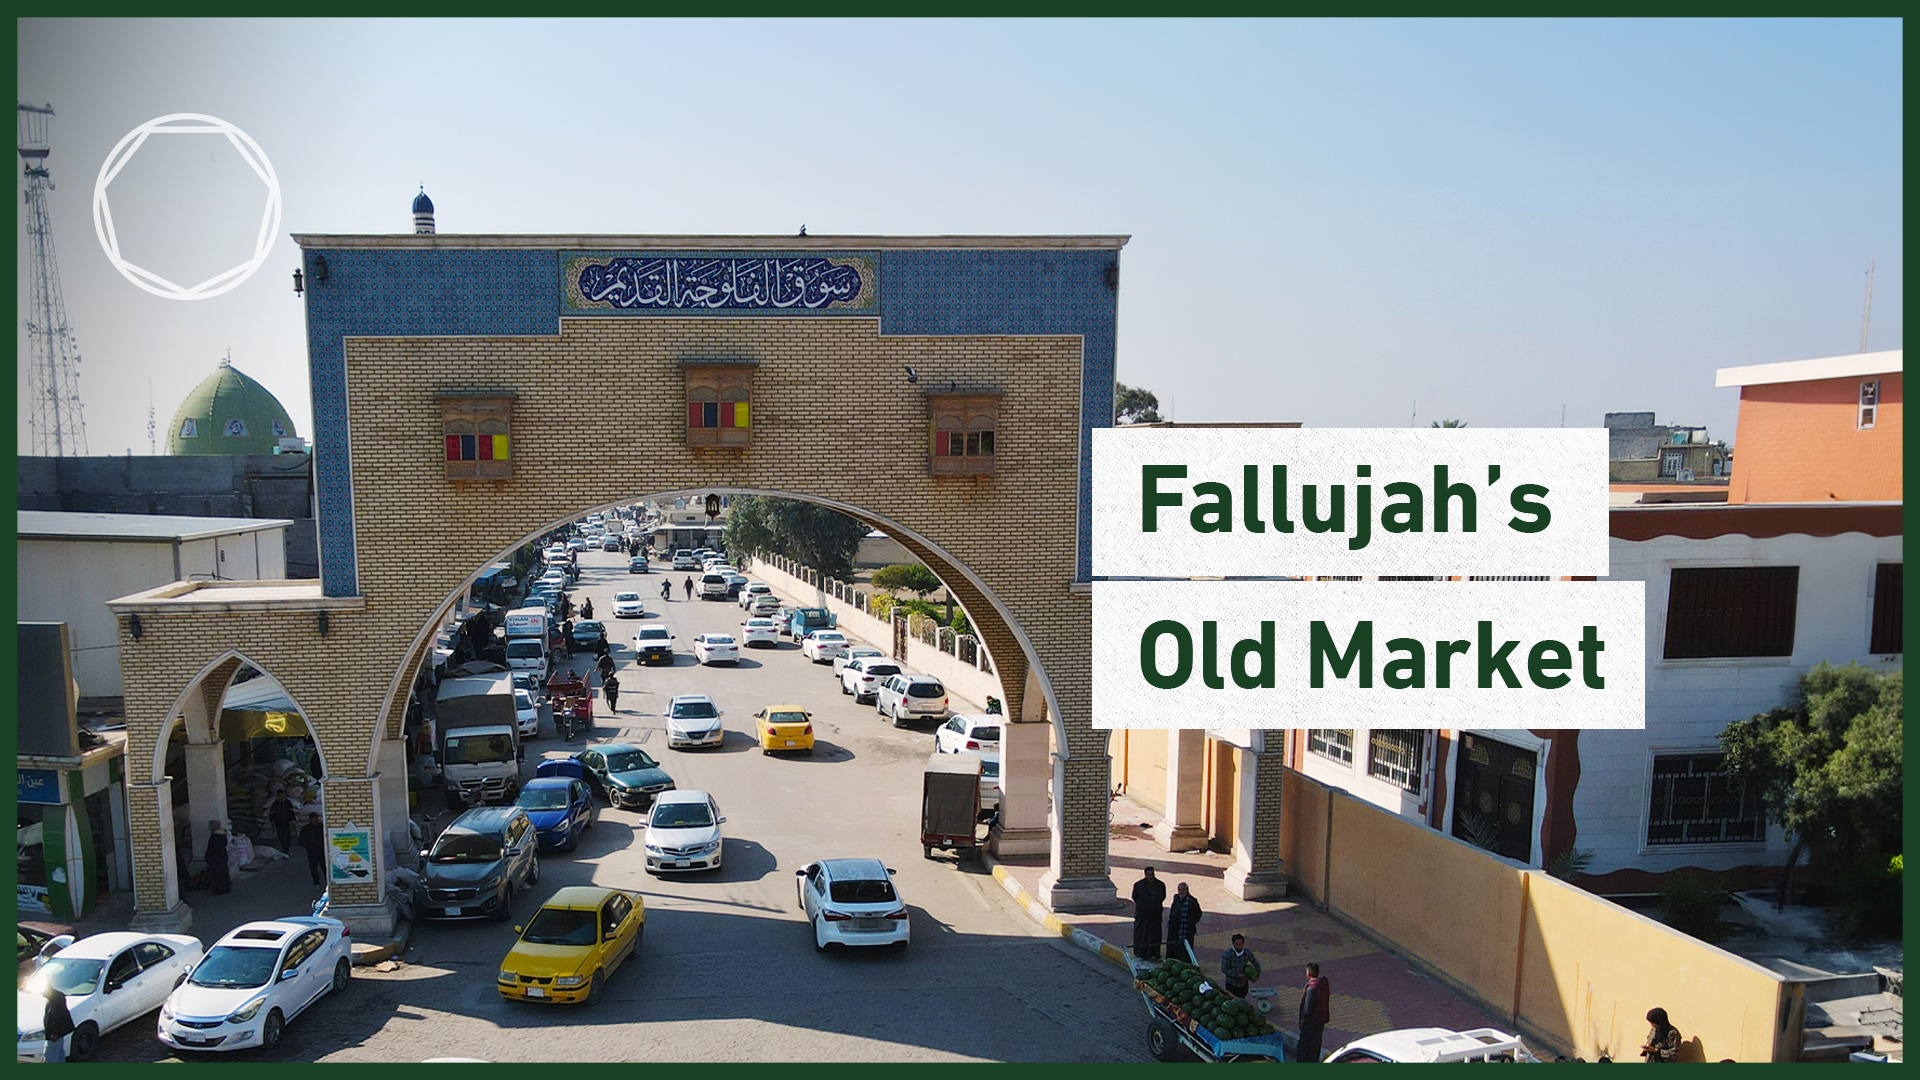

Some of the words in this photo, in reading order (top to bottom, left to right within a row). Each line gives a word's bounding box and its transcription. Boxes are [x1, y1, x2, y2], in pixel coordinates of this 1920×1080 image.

[591, 259, 679, 308] القديم
[674, 259, 780, 308] الفلوجة
[771, 264, 851, 308] سوق
